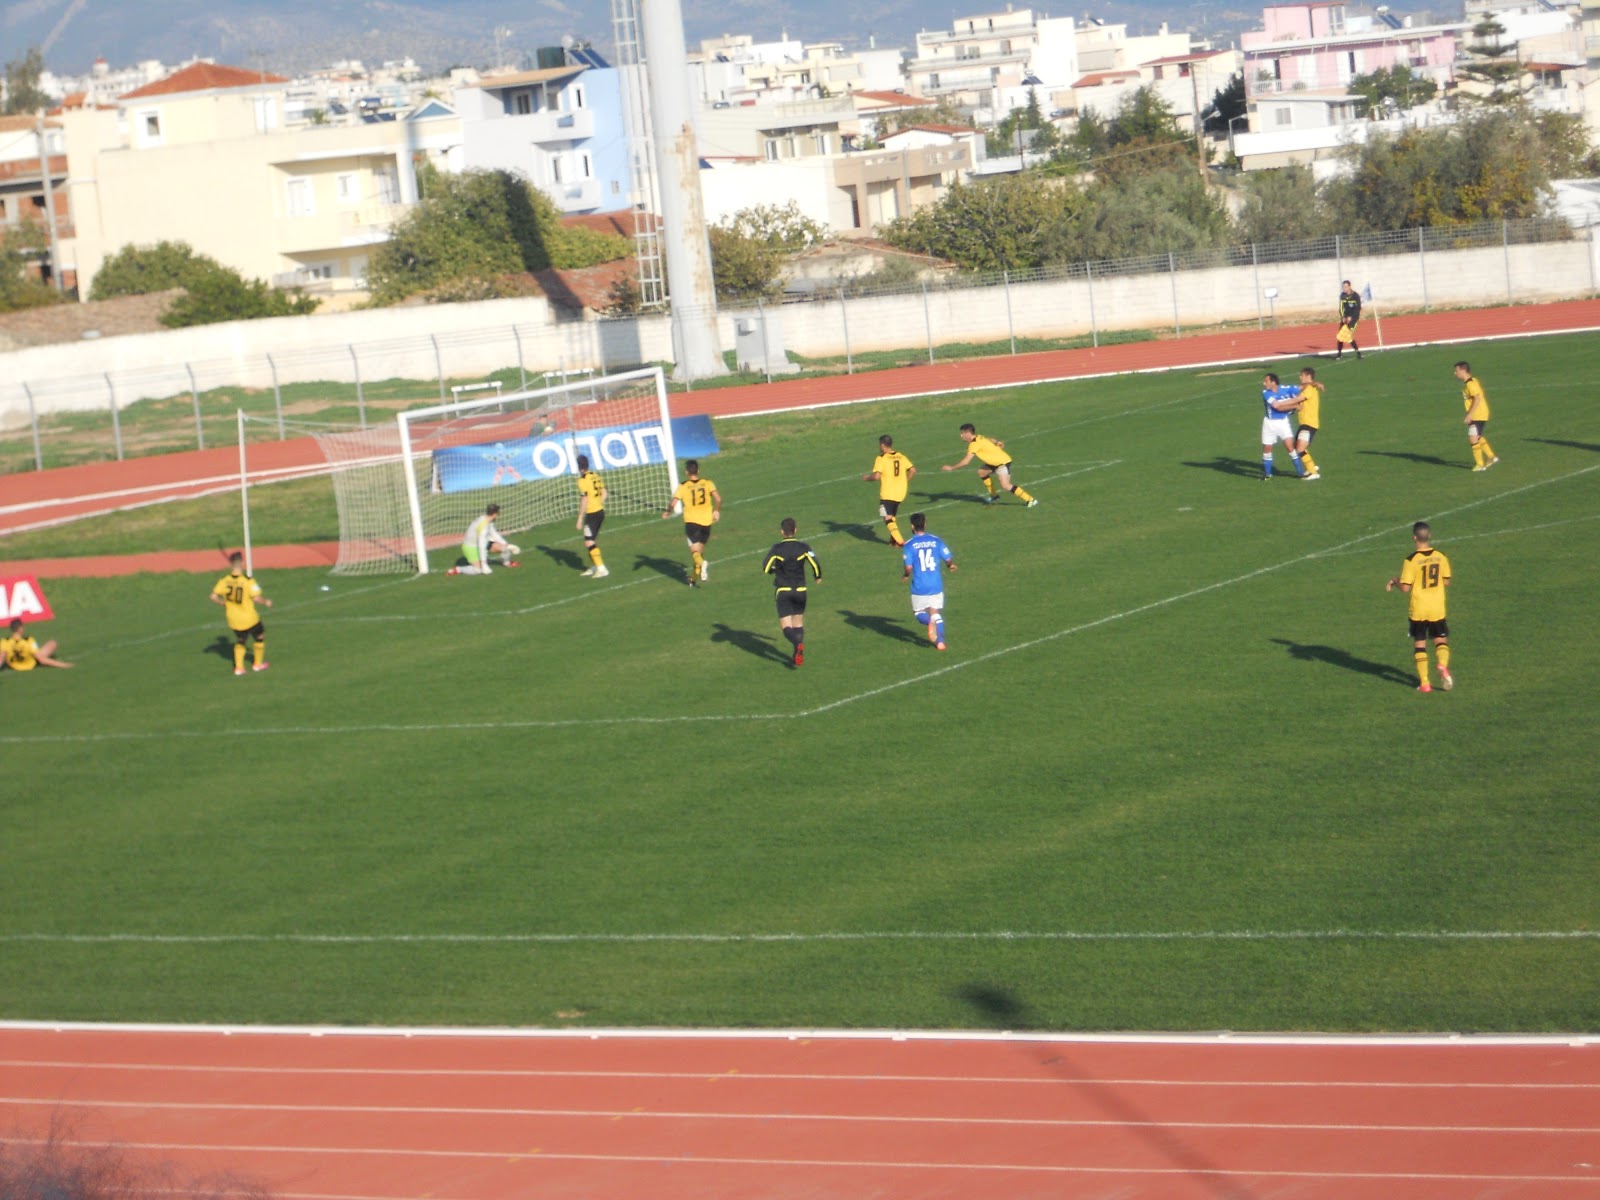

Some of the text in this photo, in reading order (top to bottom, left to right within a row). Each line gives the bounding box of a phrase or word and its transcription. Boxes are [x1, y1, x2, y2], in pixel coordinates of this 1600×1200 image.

[893, 459, 900, 477] 8
[691, 487, 706, 506] 13
[918, 548, 937, 572] 14
[1420, 563, 1440, 589] 19
[225, 585, 243, 605] 20
